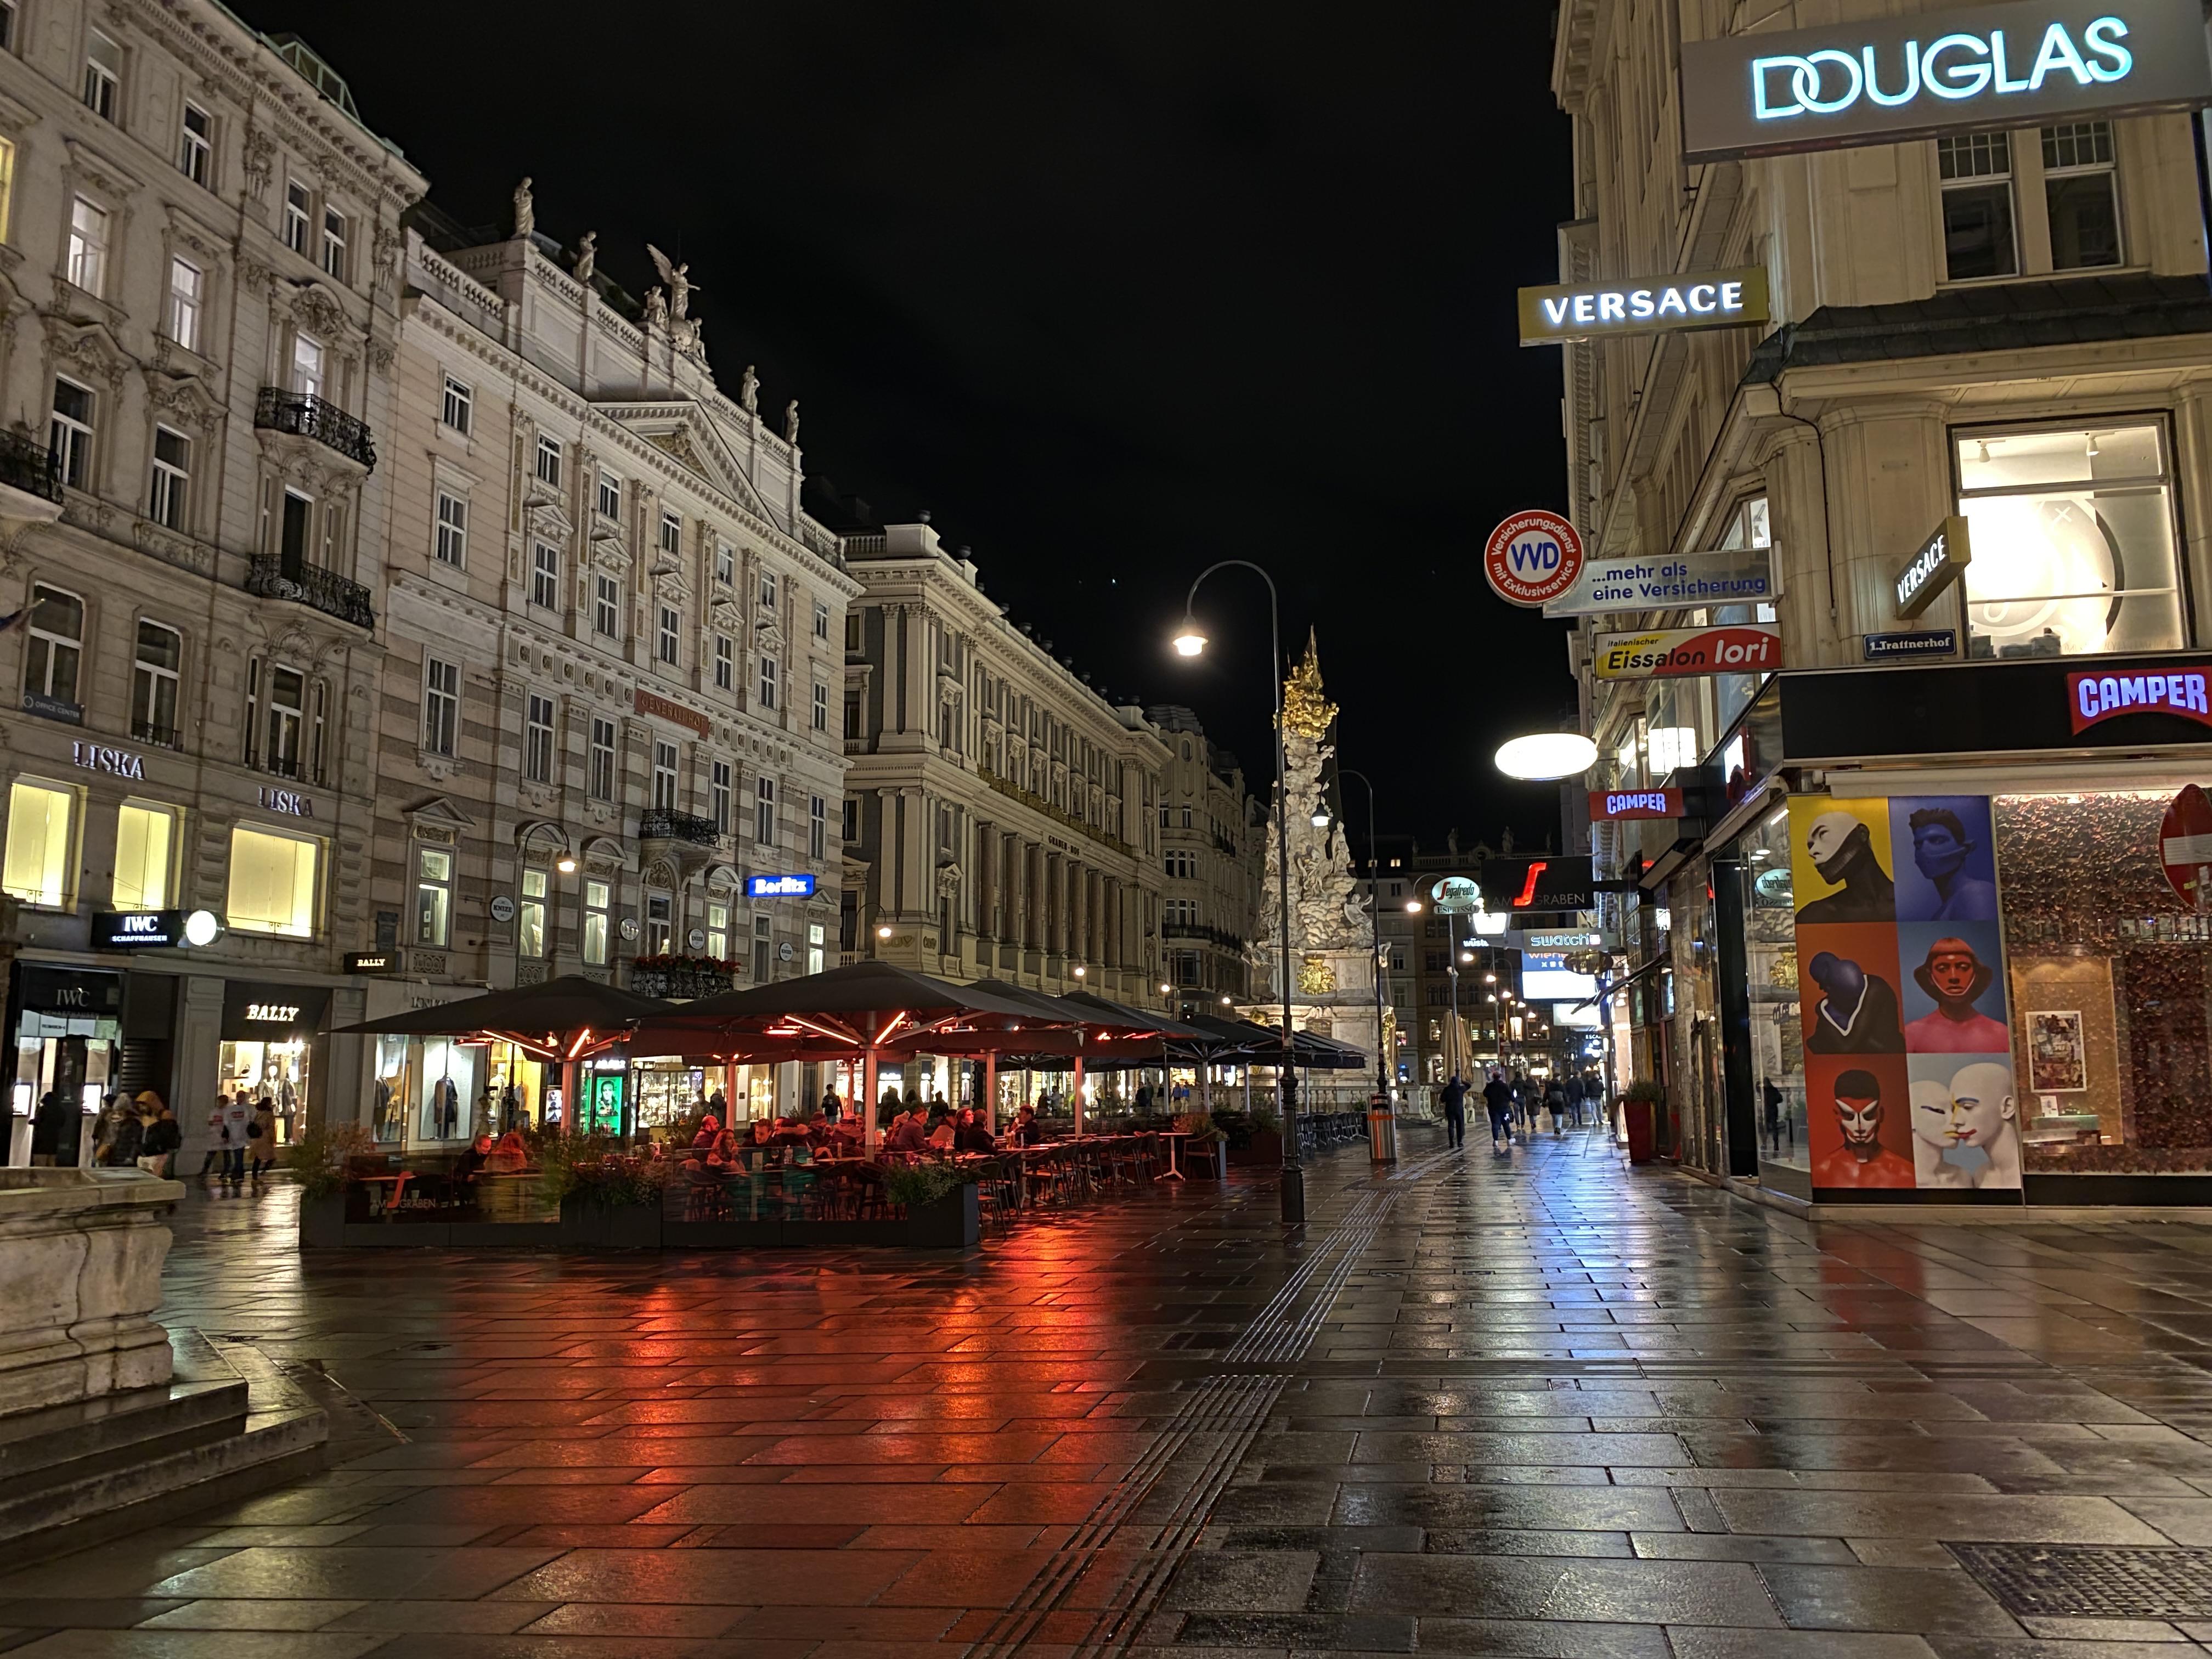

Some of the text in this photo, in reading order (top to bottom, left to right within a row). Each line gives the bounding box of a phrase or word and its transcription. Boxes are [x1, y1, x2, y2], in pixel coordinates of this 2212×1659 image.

[1750, 15, 2134, 121] DOUGLAS
[1542, 281, 1745, 326] VERSACE
[1491, 518, 1577, 556] Versicherungsdienst
[1510, 541, 1559, 572] VVD
[1661, 561, 1688, 577] als
[1897, 533, 1947, 604] VERSACE
[1493, 560, 1575, 596] mit Exklusivservice
[1593, 579, 1765, 601] eine Versicherung
[1607, 638, 1659, 647] italienischer
[1607, 648, 1706, 669] Eissalon
[2077, 673, 2209, 718] CAMPER
[35, 701, 56, 712] OFFICE
[58, 707, 80, 718] CENTER
[641, 694, 705, 729] GENERALI HOF
[73, 741, 146, 781] LISKA
[257, 786, 314, 819] LISKA
[1606, 792, 1666, 814] CAMPER
[755, 877, 807, 894] Berlitz
[1437, 882, 1475, 900] Segafredo
[493, 904, 512, 913] KNIZE
[1437, 905, 1476, 913] ESPRESSO
[1492, 896, 1511, 907] AM
[1534, 893, 1585, 905] GRABEN
[124, 916, 158, 932] IWC
[691, 935, 704, 943] KNIZE
[1531, 933, 1590, 947] swatch
[357, 958, 386, 967] BALLY
[56, 989, 90, 1007] IWC
[246, 1004, 300, 1022] BALLY
[370, 1199, 386, 1208] AM
[399, 1199, 436, 1208] GRABEN
